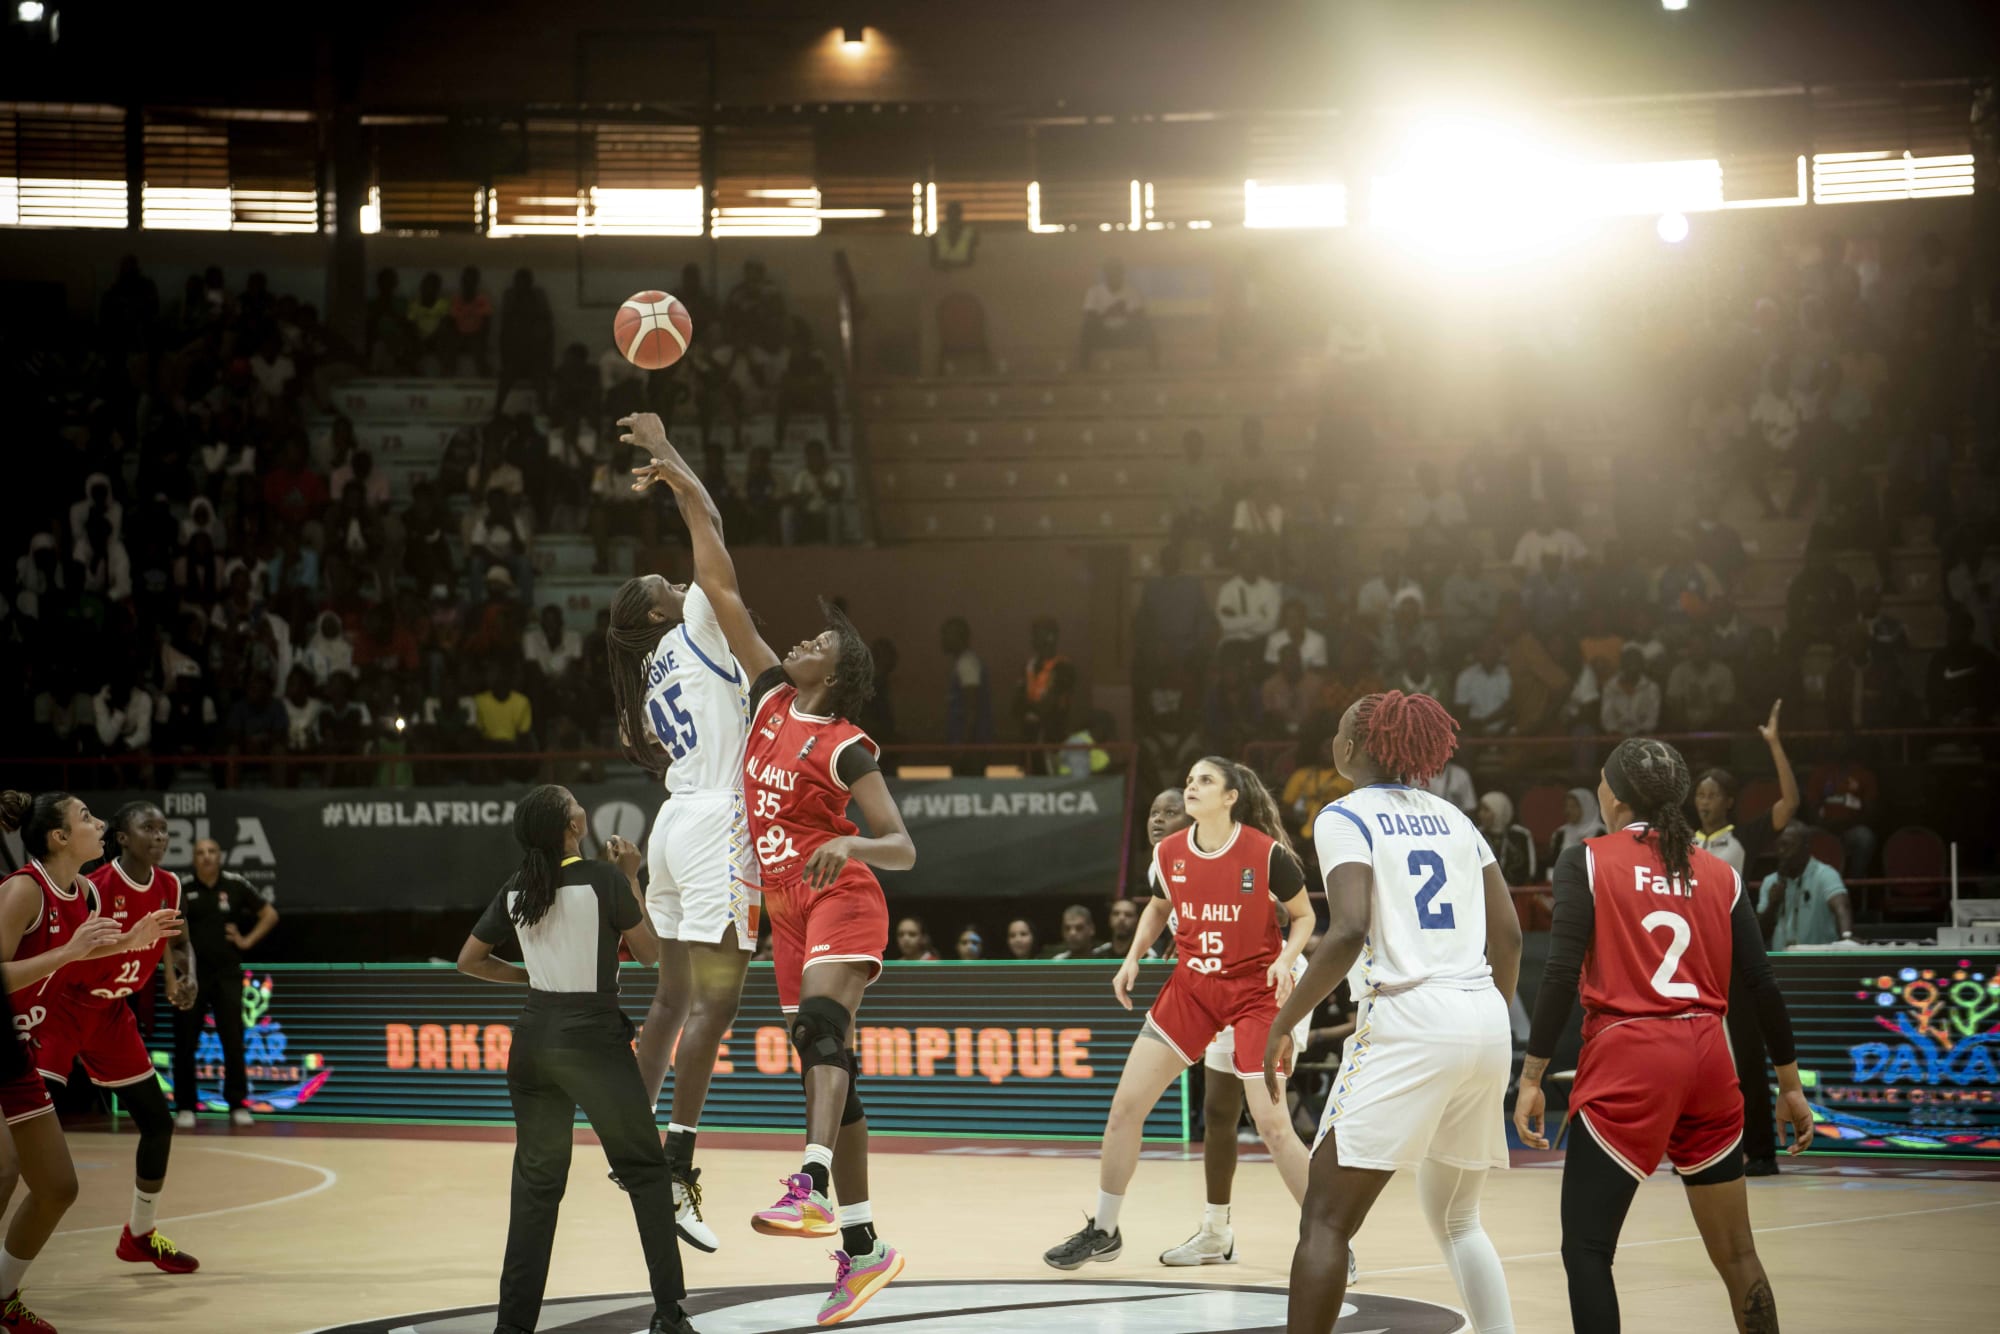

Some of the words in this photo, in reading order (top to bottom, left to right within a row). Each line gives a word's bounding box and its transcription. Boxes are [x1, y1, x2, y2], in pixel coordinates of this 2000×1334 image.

[649, 682, 698, 760] 45
[746, 755, 760, 780] AL
[758, 763, 800, 792] AHLY
[164, 792, 207, 815] FIBA
[753, 789, 782, 820] 35
[901, 791, 1099, 818] #WBLAFRICA
[1376, 813, 1451, 837] DABOU
[1407, 850, 1456, 930] 2
[1634, 865, 1699, 898] Fair
[1181, 902, 1198, 921] AL
[1201, 904, 1243, 923] AHLY
[810, 943, 831, 954] JAKO
[1198, 931, 1225, 955] 15
[1641, 910, 1700, 999] 2
[113, 960, 141, 984] 22
[385, 1023, 513, 1071] DAKA
[755, 1026, 1094, 1085] OMPIQUE
[1849, 1040, 2000, 1085] DAKA
